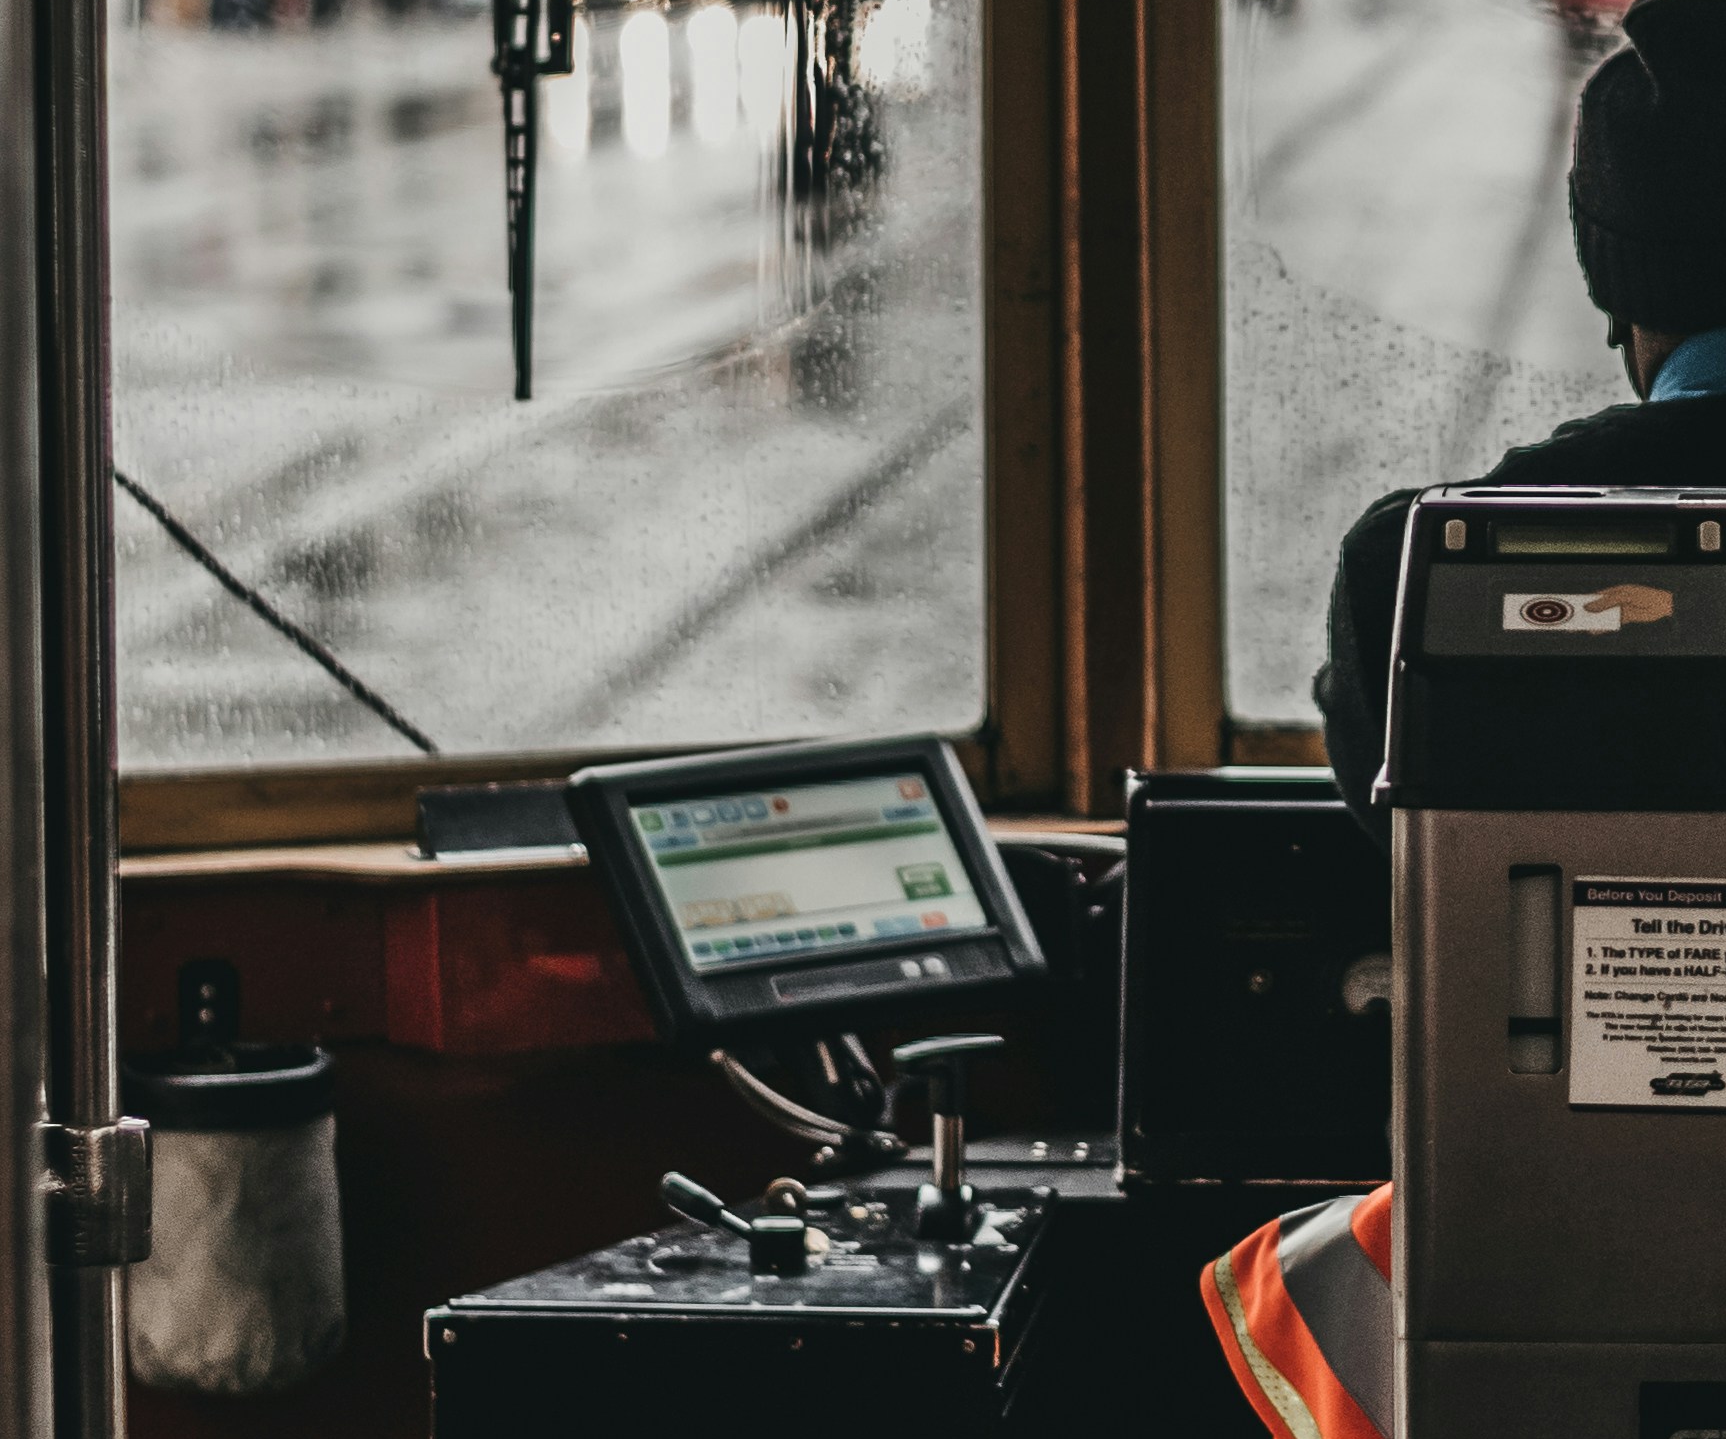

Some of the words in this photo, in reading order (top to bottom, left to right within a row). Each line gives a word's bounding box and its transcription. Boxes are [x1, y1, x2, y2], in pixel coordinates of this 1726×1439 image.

[1587, 888, 1634, 901] Before
[1638, 889, 1663, 901] You
[1668, 889, 1722, 904] Deposit
[1632, 918, 1662, 934] Tell
[1666, 919, 1695, 934] the
[1587, 946, 1597, 958] 1.
[1601, 946, 1626, 958] The
[1628, 947, 1665, 959] TYPE
[1667, 948, 1681, 959] of
[1684, 948, 1722, 960] FARE
[1585, 963, 1597, 975] 2.
[1600, 964, 1610, 975] If
[1613, 966, 1637, 978] you
[1640, 964, 1672, 976] have
[1674, 967, 1682, 977] a
[1614, 991, 1655, 1002] Change
